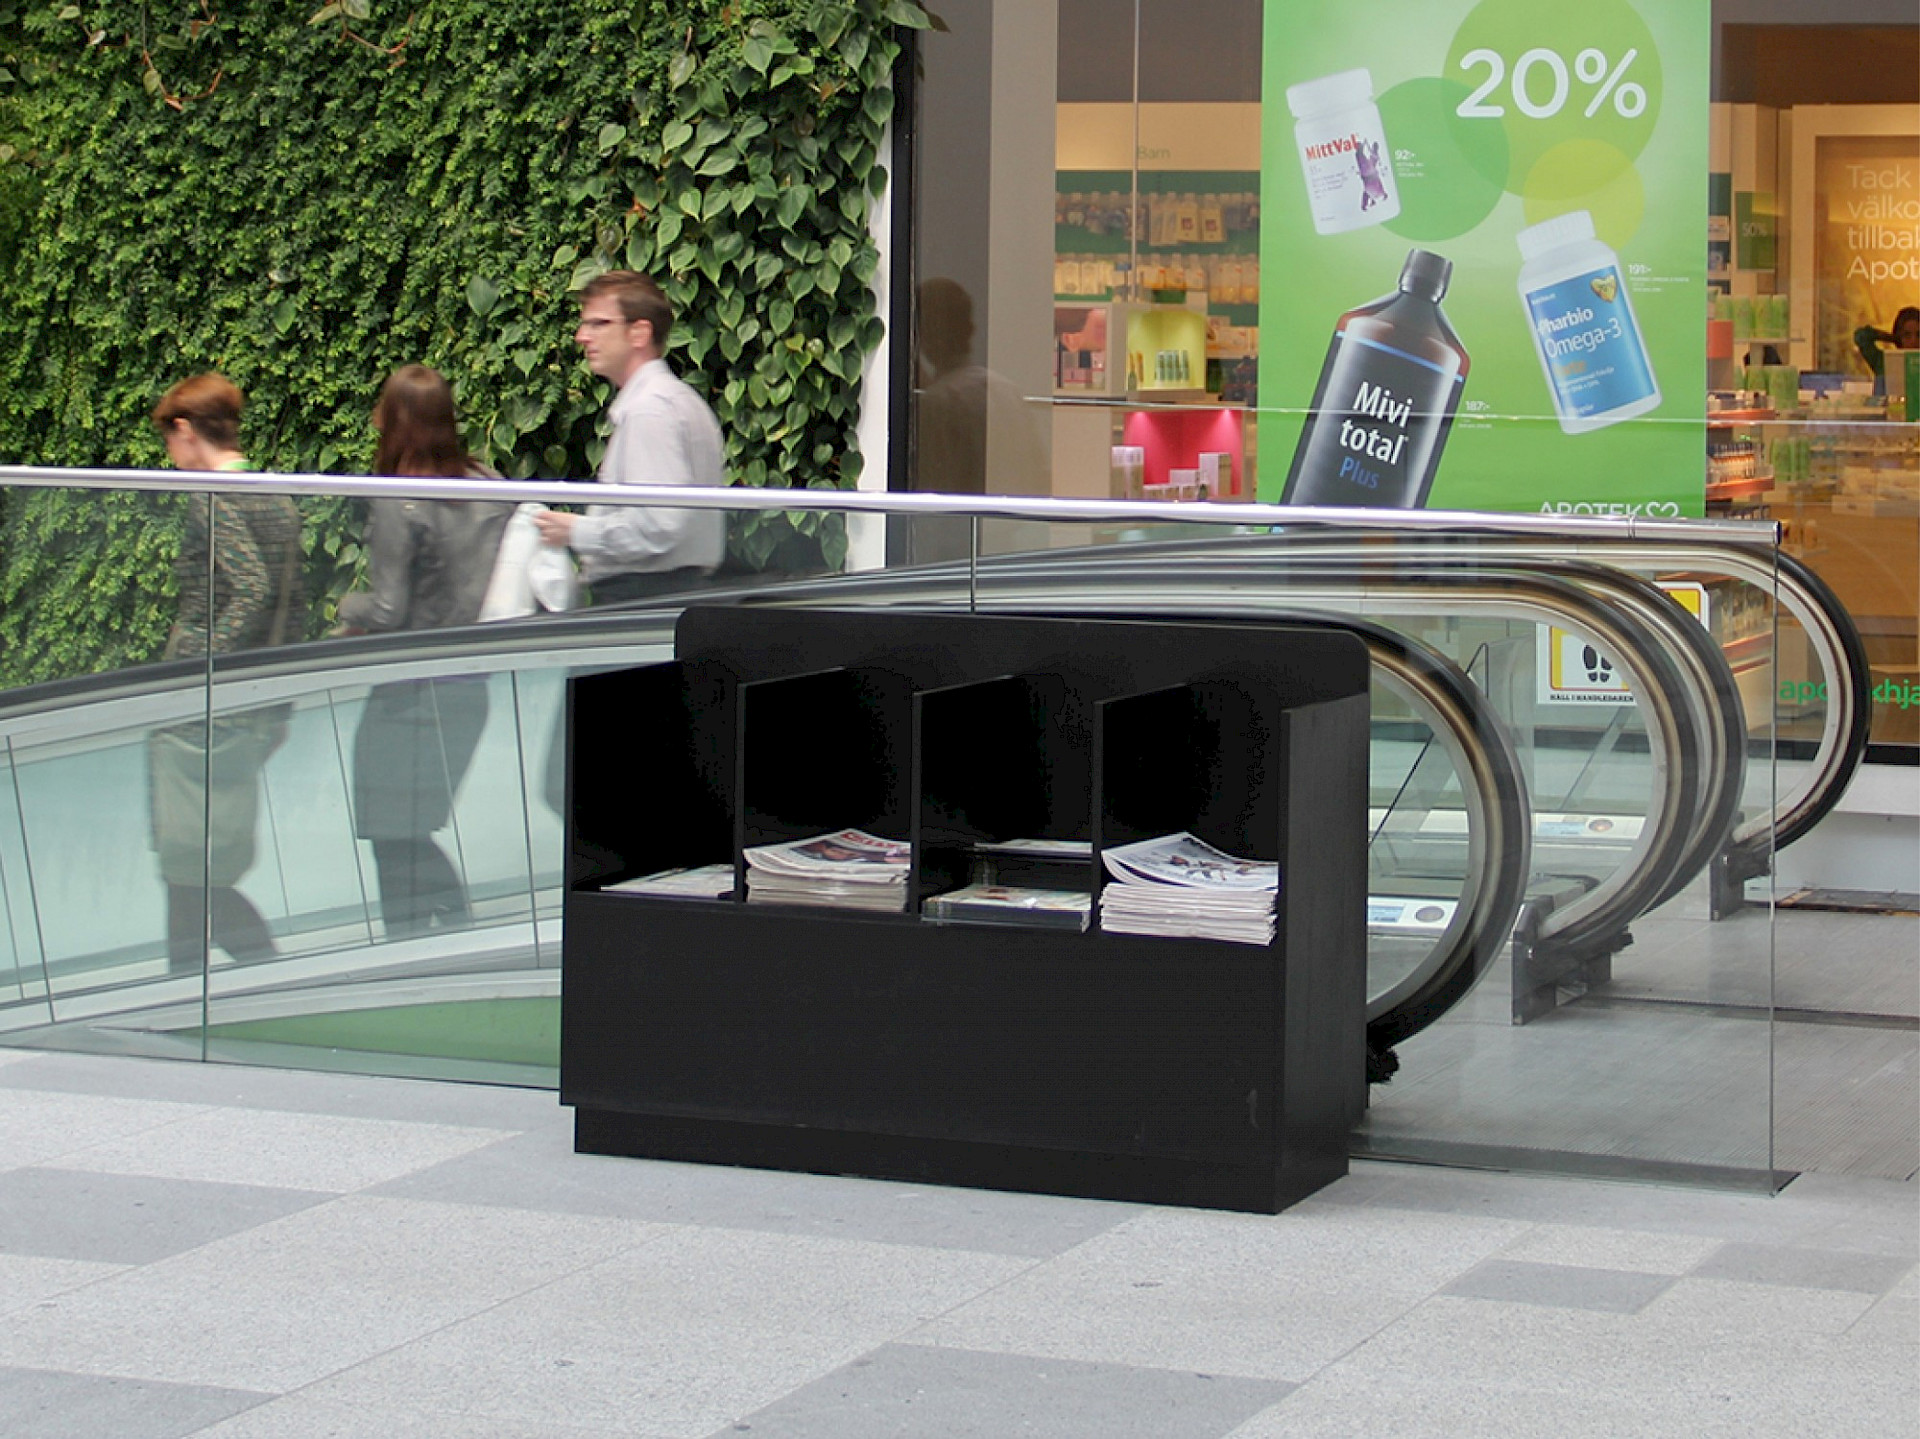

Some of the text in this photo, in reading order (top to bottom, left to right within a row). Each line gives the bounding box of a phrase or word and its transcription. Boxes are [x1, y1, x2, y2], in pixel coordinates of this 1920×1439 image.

[1456, 48, 1647, 119] 20%
[1305, 133, 1360, 161] MittVal
[1847, 164, 1912, 189] Tack
[1544, 317, 1622, 358] Omega-3
[1353, 381, 1413, 428] Mivi
[1339, 418, 1405, 465] total
[1339, 456, 1380, 489] Plus
